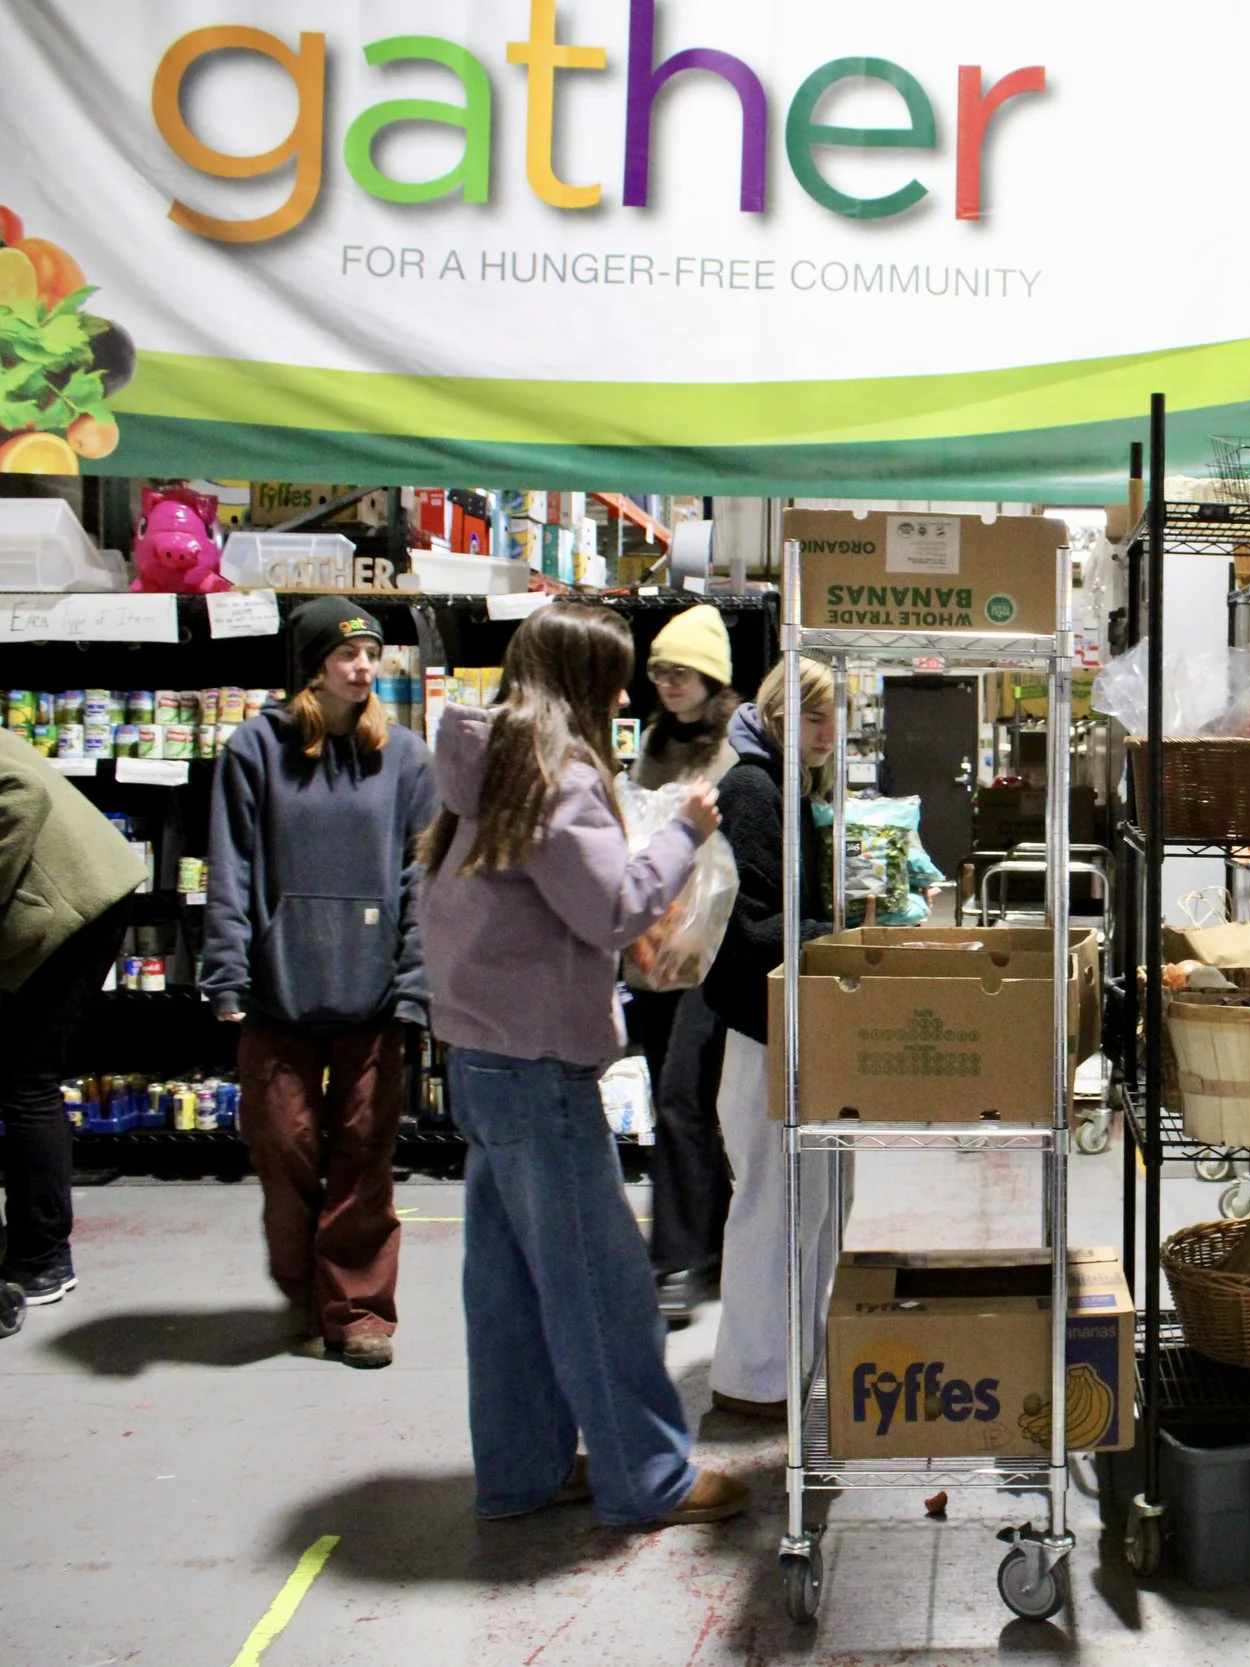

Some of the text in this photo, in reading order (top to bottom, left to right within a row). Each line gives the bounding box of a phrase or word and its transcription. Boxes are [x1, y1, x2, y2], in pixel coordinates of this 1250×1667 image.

[151, 0, 1045, 243] gather
[342, 245, 1042, 299] FOR A HUNGER-FREE COMMUNITY
[265, 555, 394, 589] GATHER
[827, 584, 973, 609] BANANAS
[828, 609, 973, 627] WHOLE TRADE
[1066, 1325, 1117, 1339] ananas
